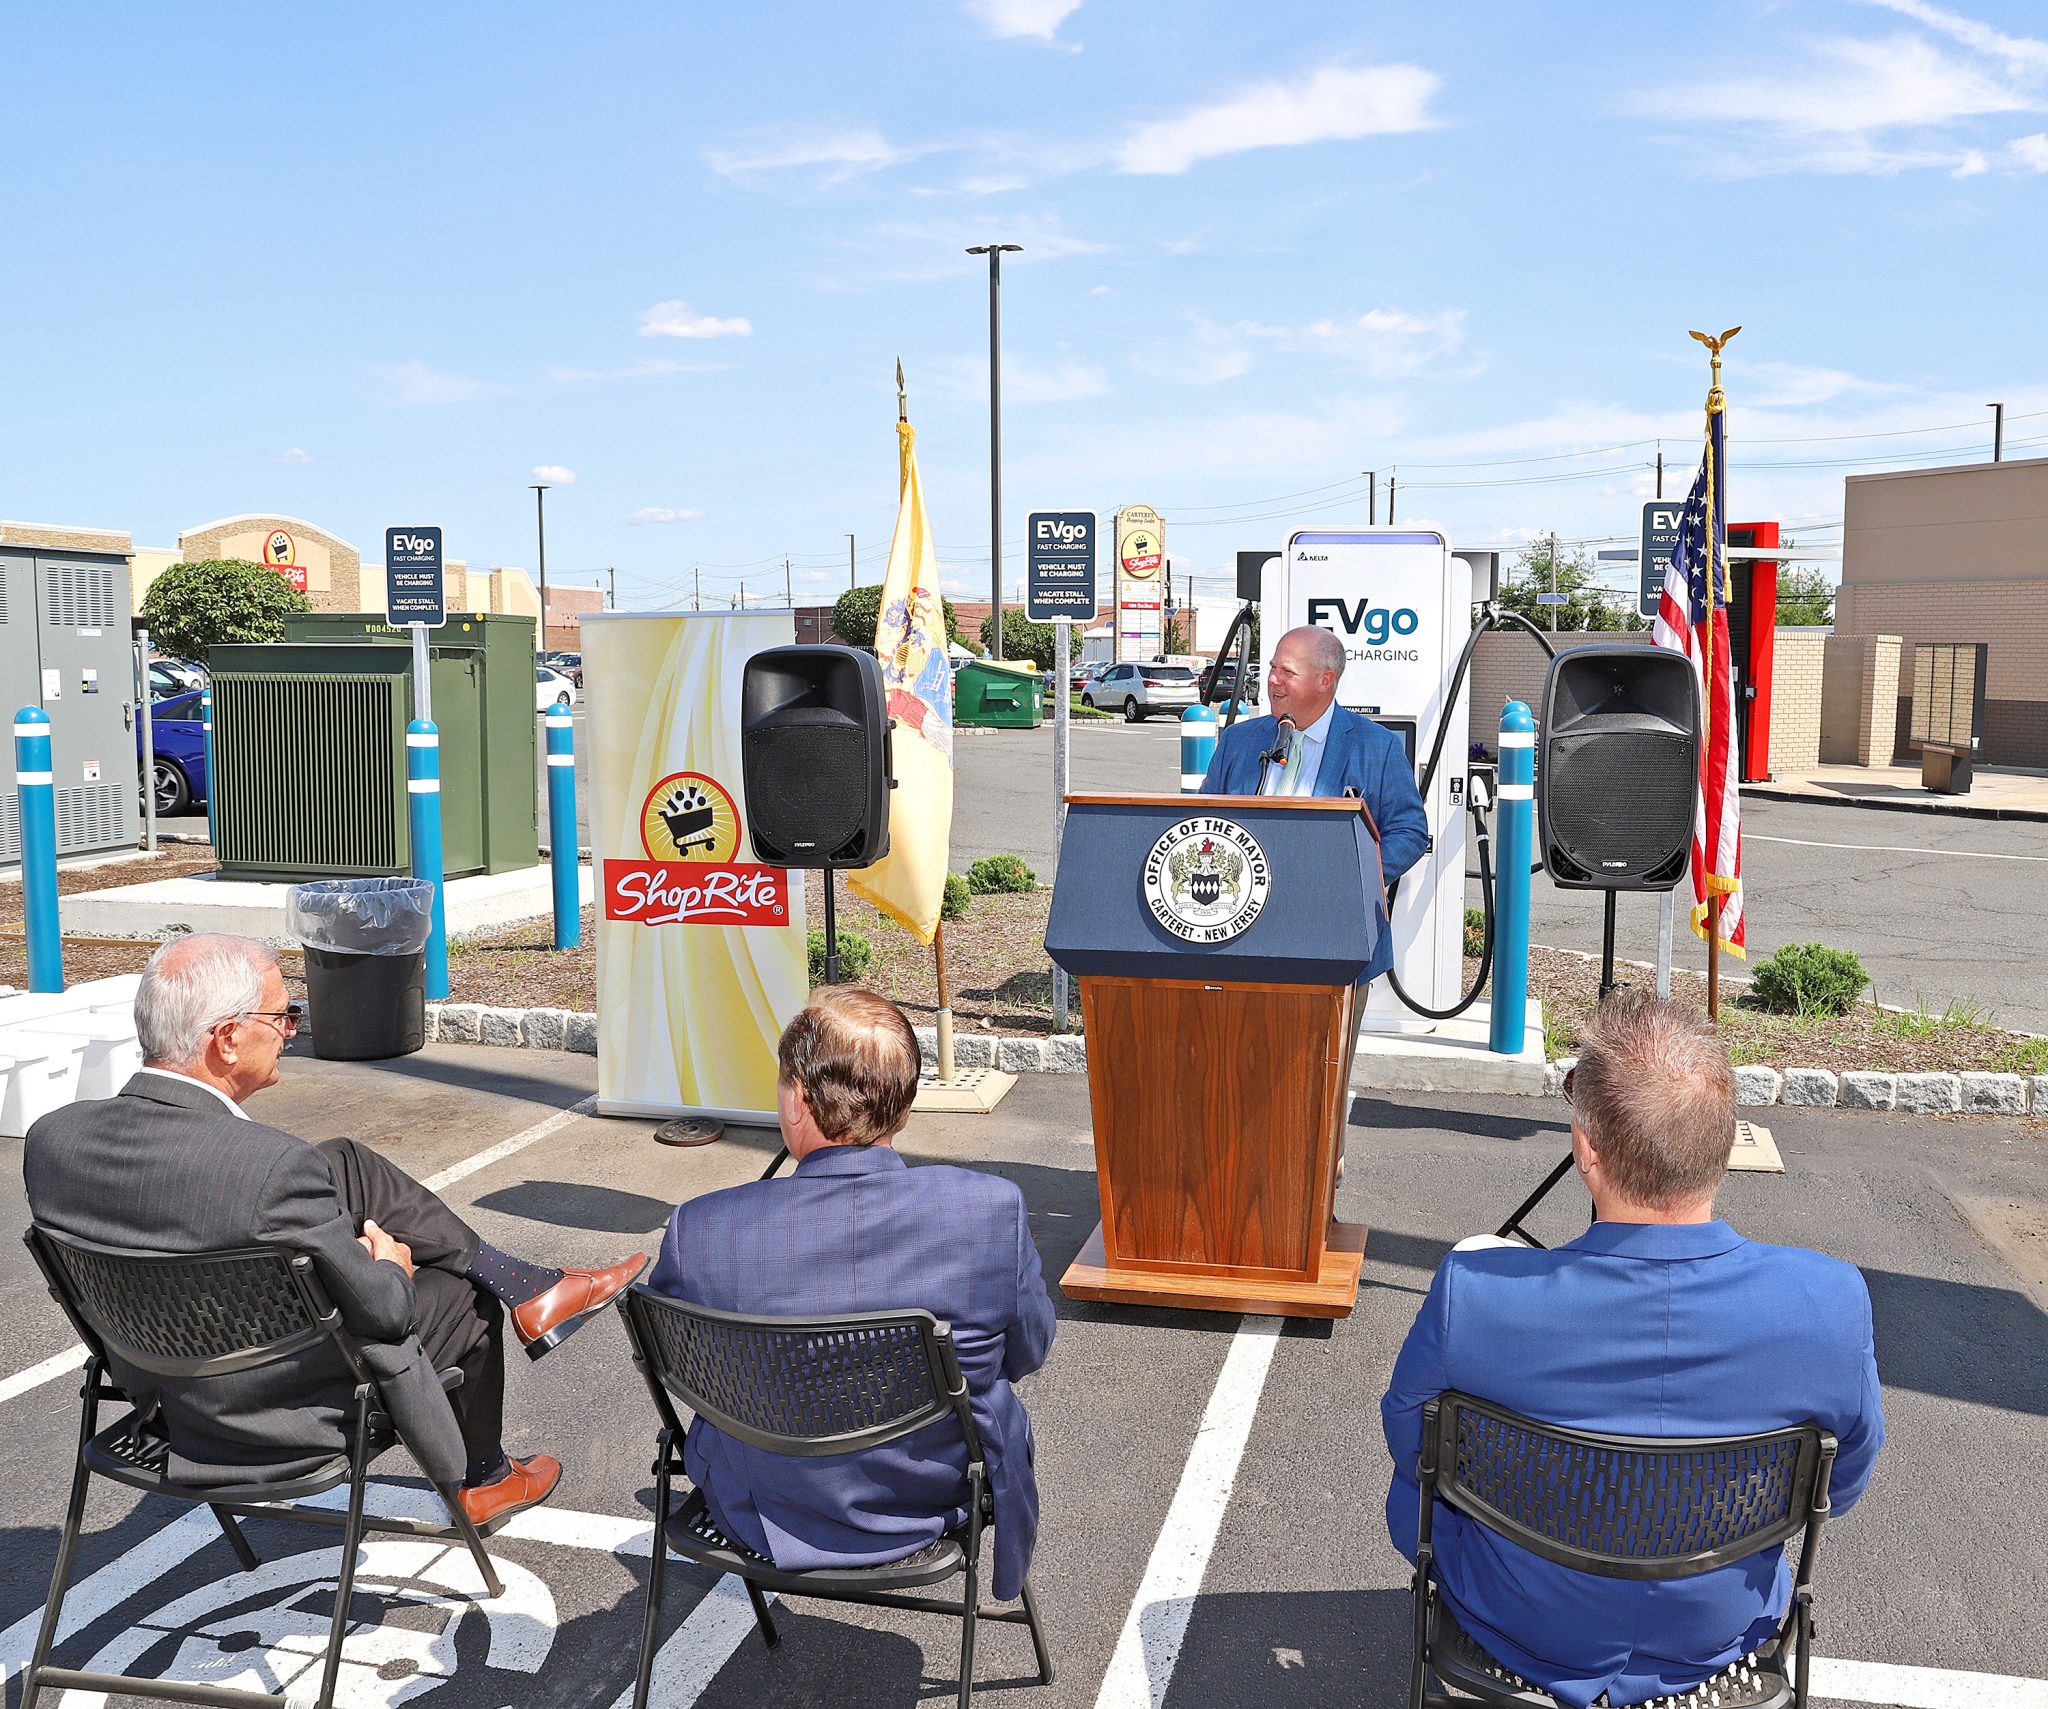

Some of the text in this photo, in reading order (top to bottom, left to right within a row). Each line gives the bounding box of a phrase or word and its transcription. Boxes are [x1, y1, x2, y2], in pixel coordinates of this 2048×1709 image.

[1653, 511, 1684, 530] EV
[1037, 520, 1087, 543] EVgo
[393, 534, 435, 555] EVgo
[1651, 556, 1671, 564] VEHI
[1033, 597, 1090, 605] WHEN COMPLETE
[1308, 598, 1419, 646] EVgo
[1345, 649, 1419, 661] CHARGING
[1452, 794, 1460, 804] B
[1147, 819, 1266, 887] OFFICE OF THE MAYOR
[1151, 898, 1261, 941] CARTERET NEW JERSEY
